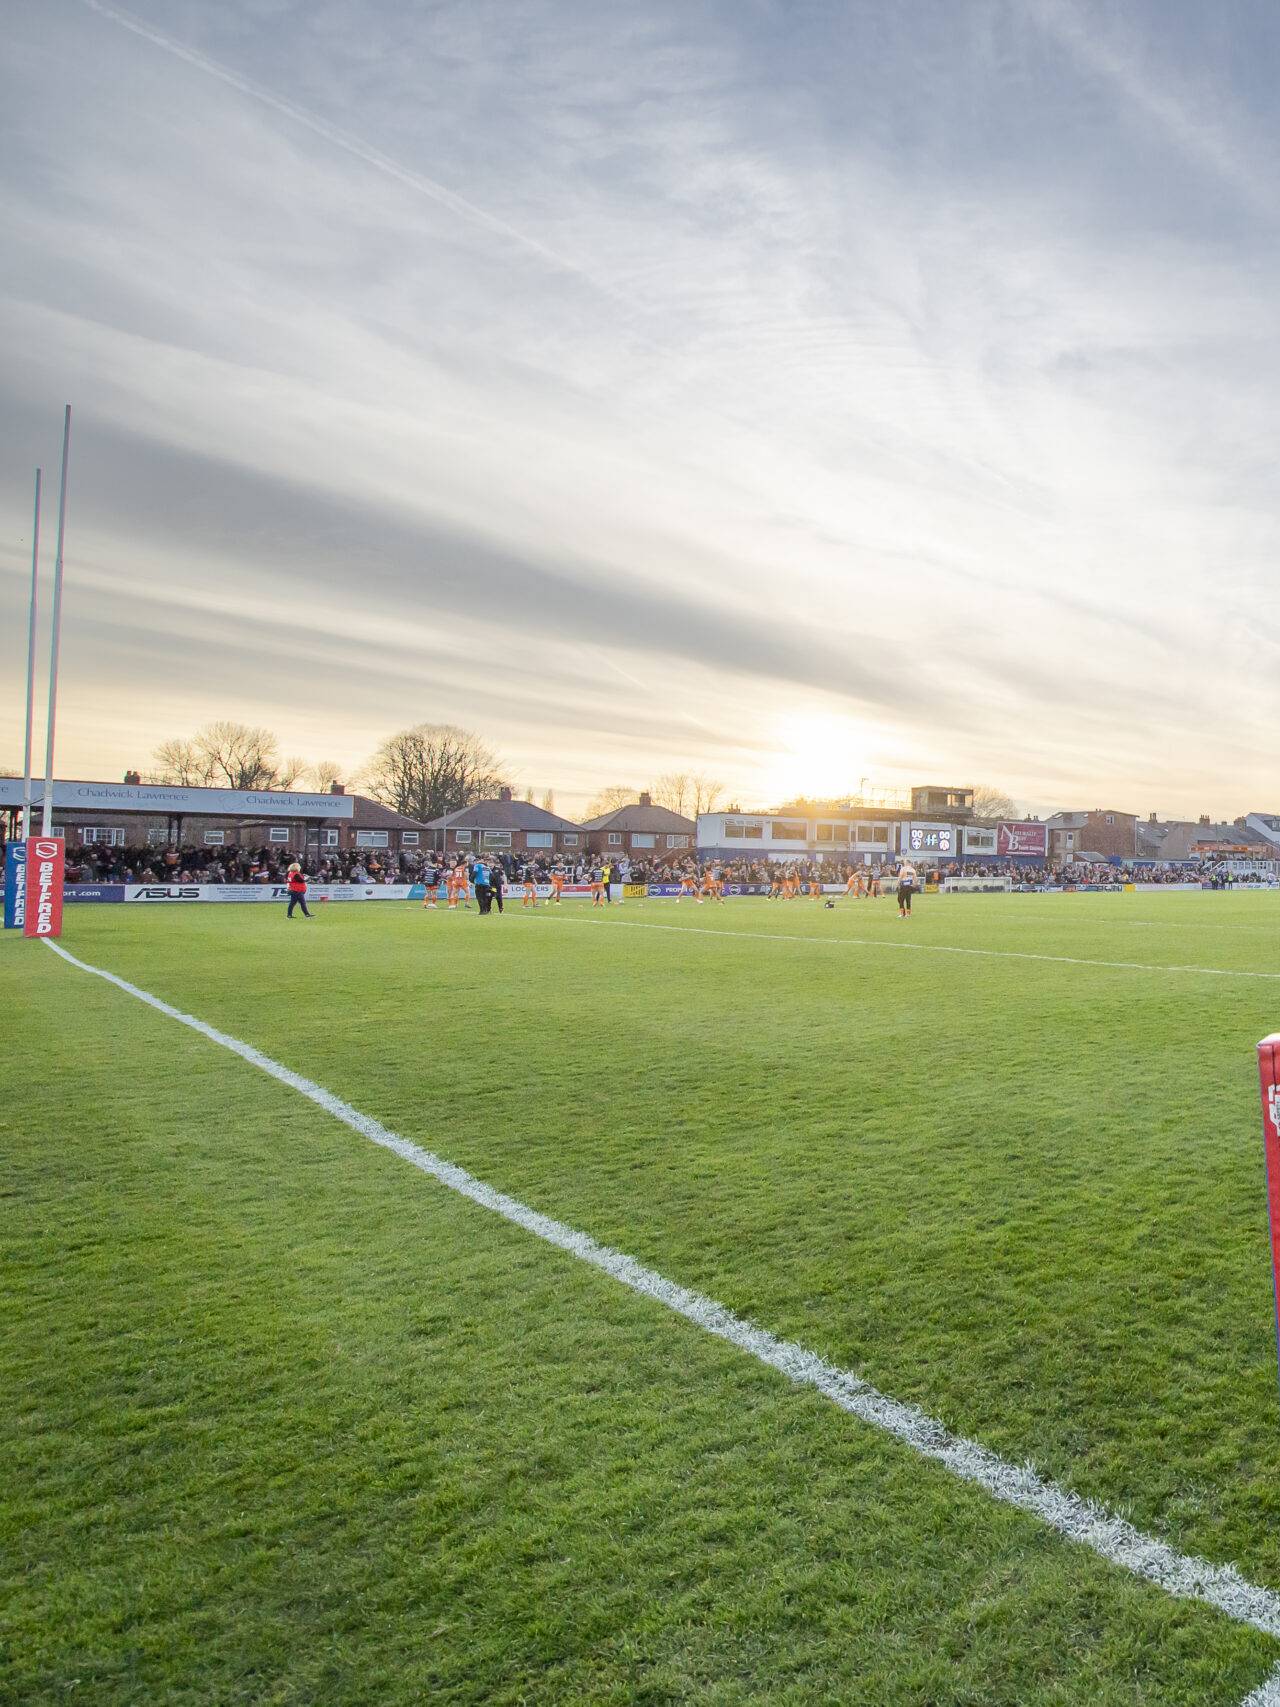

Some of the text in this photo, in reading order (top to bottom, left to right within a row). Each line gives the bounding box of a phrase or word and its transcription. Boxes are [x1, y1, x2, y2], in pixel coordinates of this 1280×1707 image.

[77, 787, 189, 801] Chadwick Lawrence
[246, 794, 342, 808] Chadwick Lawrence
[36, 862, 54, 934] BETFRED
[133, 887, 200, 899] ASUS
